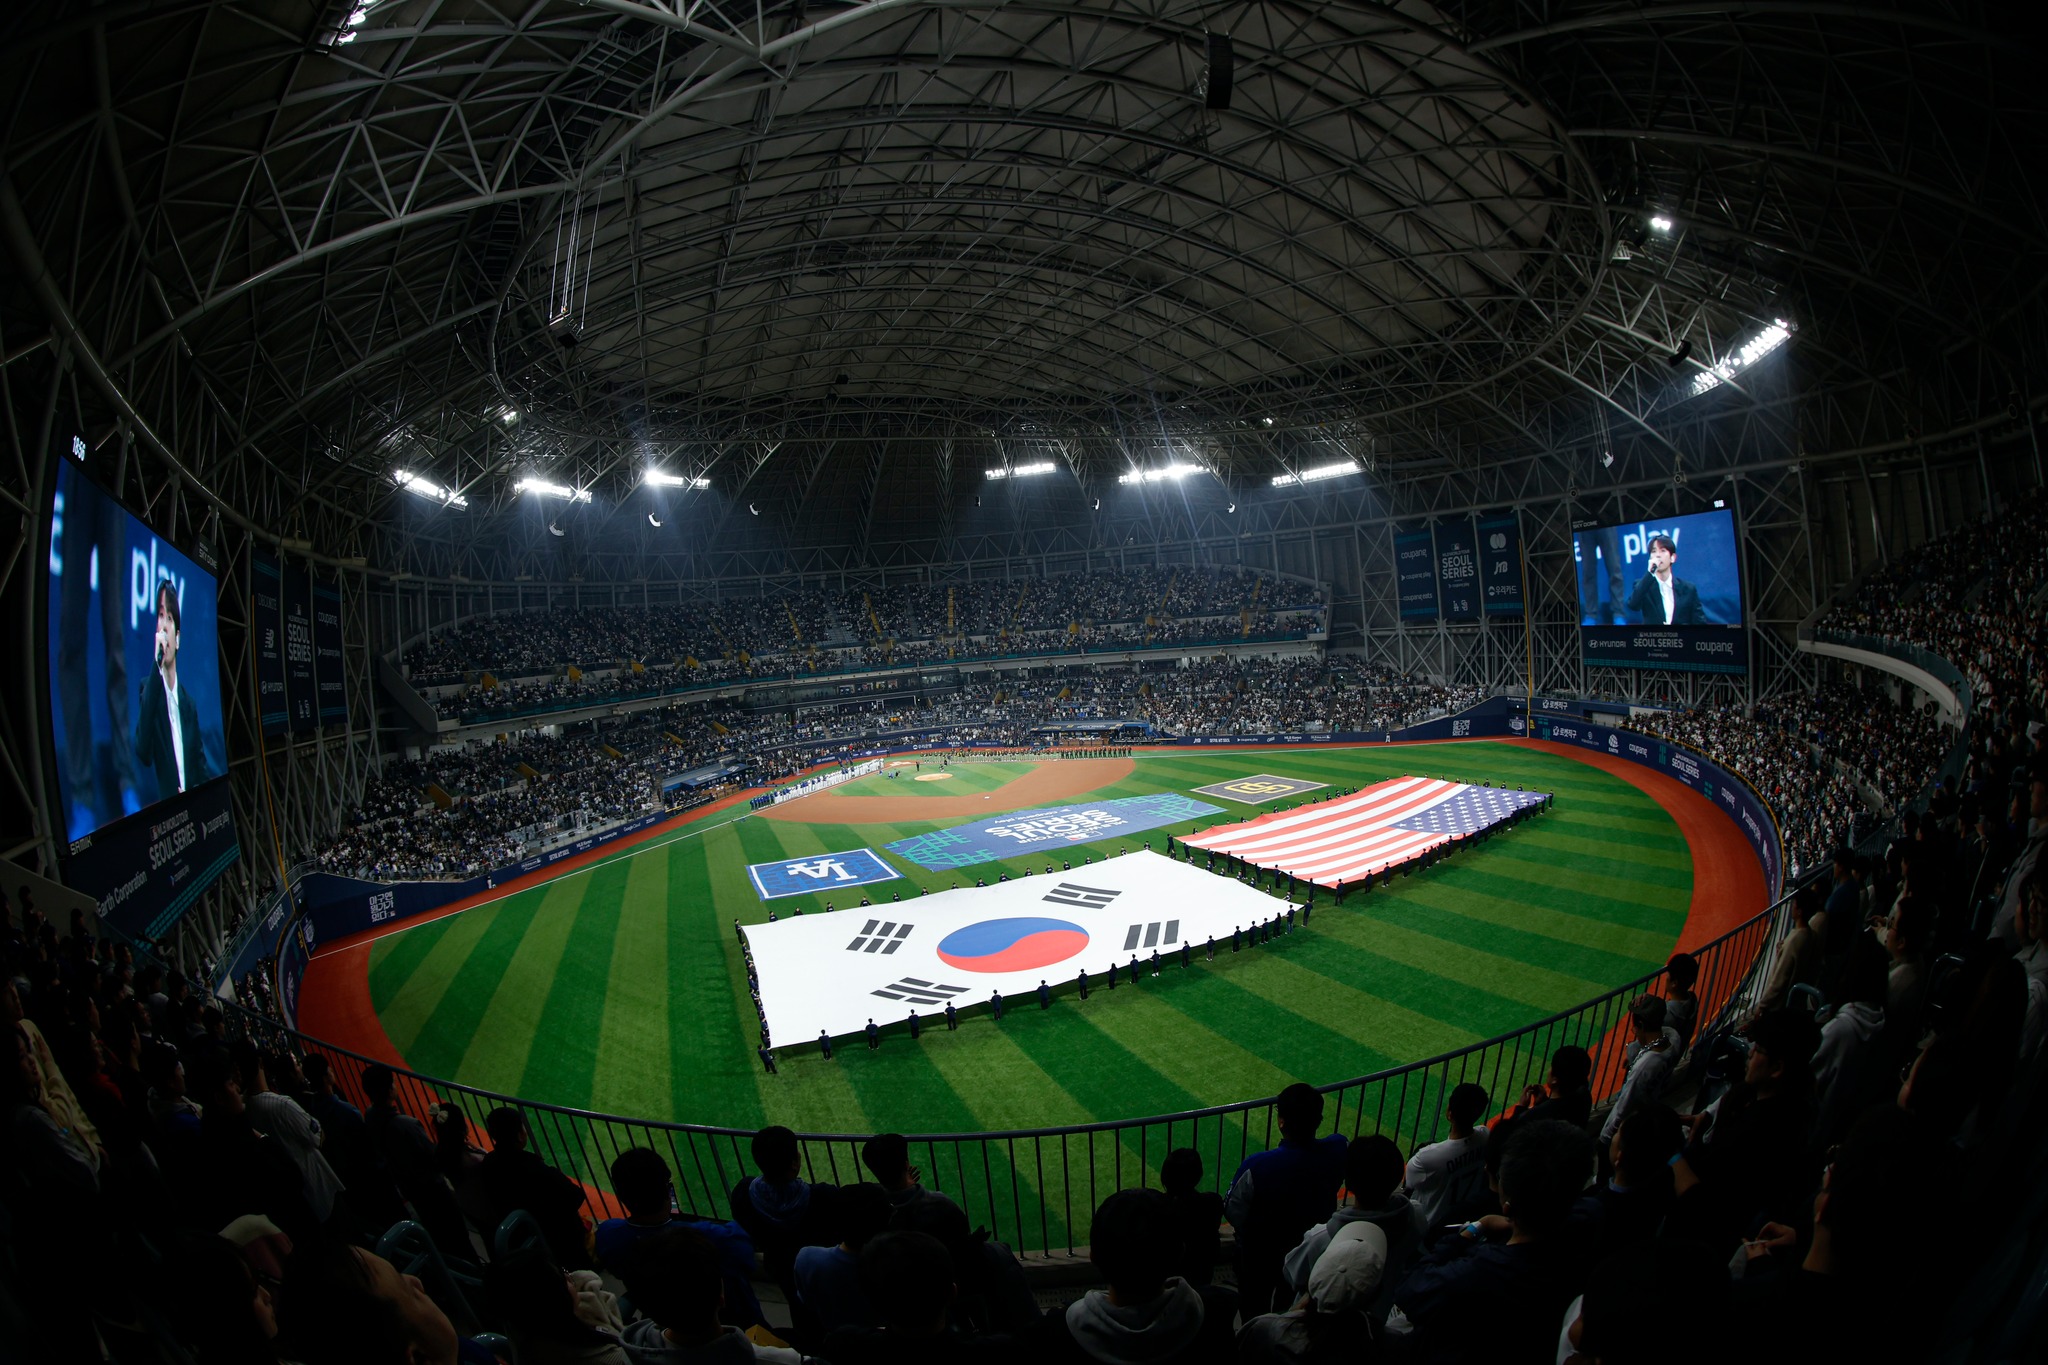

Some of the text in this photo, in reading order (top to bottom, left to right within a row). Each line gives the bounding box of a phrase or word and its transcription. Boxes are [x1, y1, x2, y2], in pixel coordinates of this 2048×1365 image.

[1401, 549, 1427, 559] coupang
[1442, 555, 1472, 568] SEOUL
[1442, 565, 1474, 579] SERIES
[1495, 586, 1518, 595] 우리카드
[288, 623, 310, 644] SEOUL
[1633, 638, 1684, 648] SEOUL SERIES
[1696, 641, 1733, 655] coupang
[288, 643, 311, 662] SERIES
[1629, 743, 1647, 758] coupang
[1671, 757, 1686, 772] SEOUL
[1685, 764, 1699, 779] SERIES
[985, 809, 1108, 835] SERIES
[993, 815, 1122, 840] SEOUL
[1017, 834, 1054, 844] TOUR
[1054, 825, 1101, 838] WORLD
[149, 822, 196, 870] SEOUL SERIES
[786, 859, 858, 881] LA
[113, 870, 148, 904] Corporation
